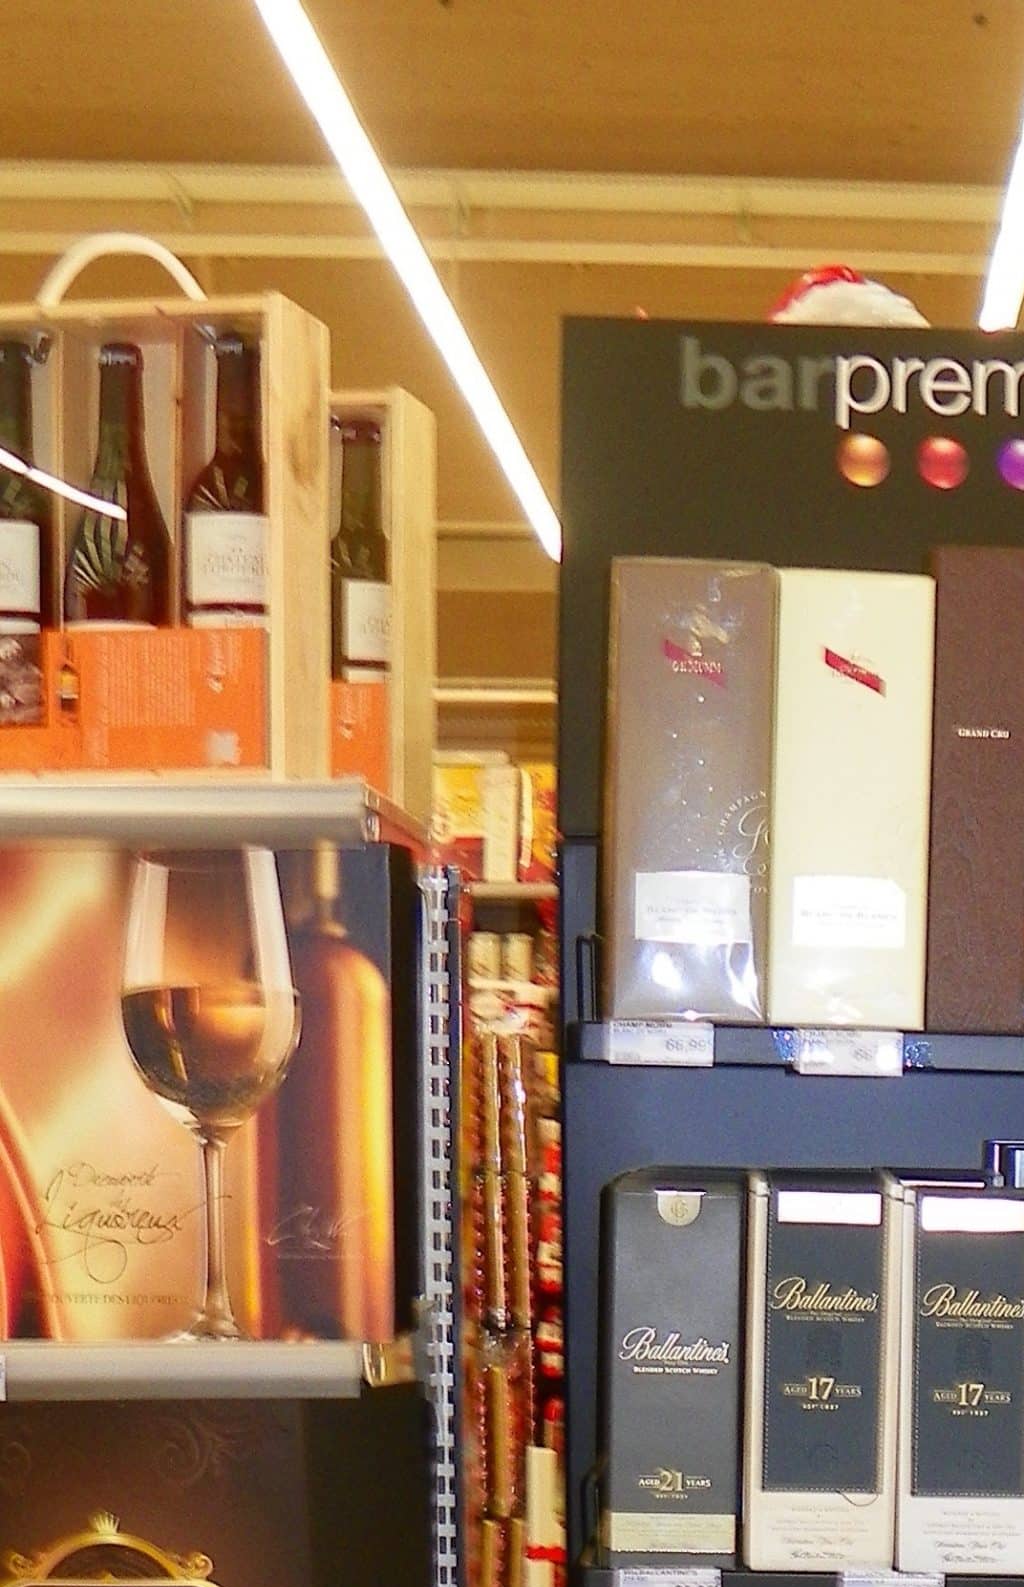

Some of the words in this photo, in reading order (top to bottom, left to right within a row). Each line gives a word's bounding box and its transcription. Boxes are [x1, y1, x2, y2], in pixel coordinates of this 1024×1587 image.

[680, 336, 832, 412] bar
[957, 726, 989, 739] GRAND
[990, 728, 1010, 740] CRU
[807, 1377, 835, 1400] 17
[835, 1386, 862, 1397] YEARS
[957, 1383, 985, 1406] 17
[638, 1477, 660, 1488] AGED
[659, 1469, 685, 1493] 21
[686, 1478, 712, 1489] YEARS
